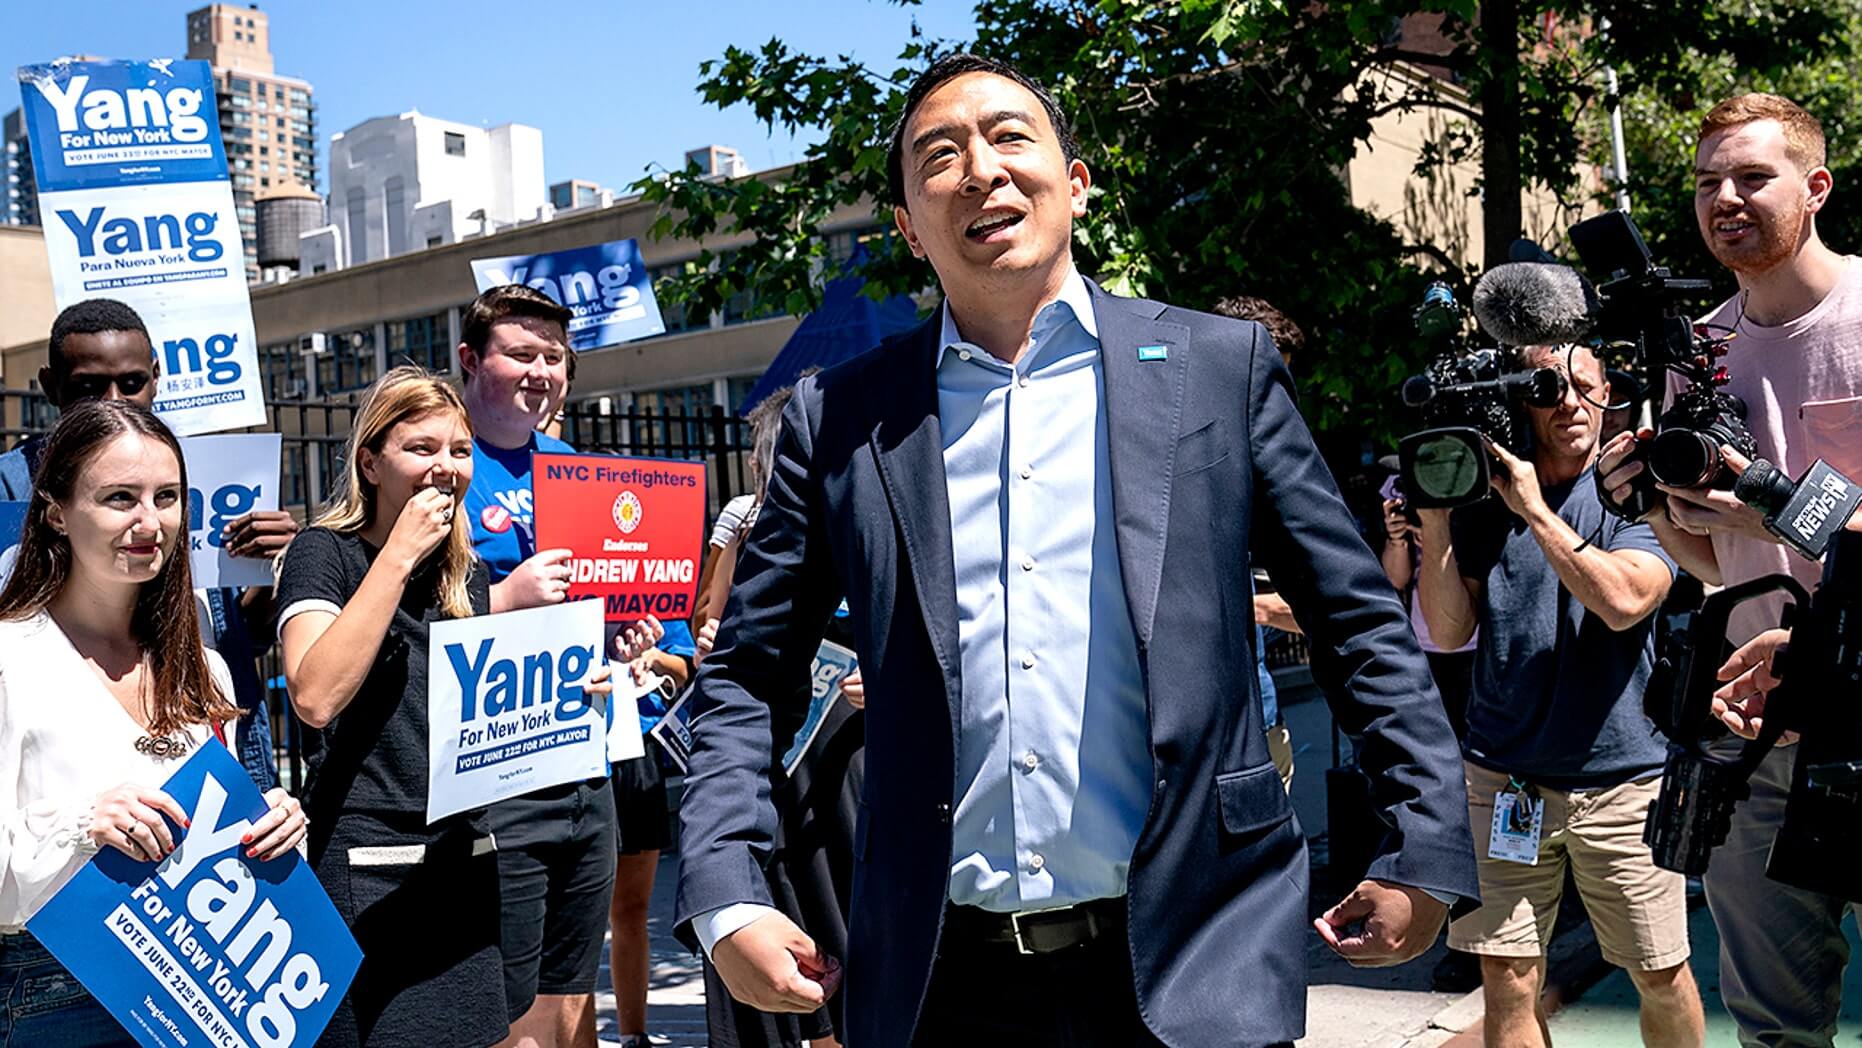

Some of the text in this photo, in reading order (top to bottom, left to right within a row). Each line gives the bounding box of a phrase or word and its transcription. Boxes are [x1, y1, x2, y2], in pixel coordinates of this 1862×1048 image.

[33, 75, 208, 142] Yang
[60, 127, 171, 149] For New York
[69, 153, 93, 161] VOTE
[96, 151, 120, 159] JUNE
[55, 206, 224, 262] Yang
[80, 253, 186, 273] Para Nueva York
[569, 302, 603, 317] York
[163, 332, 242, 385] ng
[547, 464, 697, 488] NYC Firefighters
[1797, 491, 1837, 541] NEWS
[602, 538, 649, 552] Endorses
[567, 558, 694, 583] NDREW YANG
[606, 592, 689, 614] MAYOR
[443, 637, 595, 723] Yang
[458, 709, 551, 748] For New York
[459, 755, 482, 769] VOTE
[482, 749, 505, 764] JUNE
[521, 740, 538, 753] FOR
[538, 736, 556, 749] NYC
[556, 728, 588, 744] MAYOR
[155, 770, 330, 1048] Yang
[130, 877, 248, 1018] For New York
[115, 913, 148, 949] VOTE
[143, 946, 174, 978] JUNE
[191, 999, 214, 1025] FOR
[210, 1021, 233, 1048] NYC
